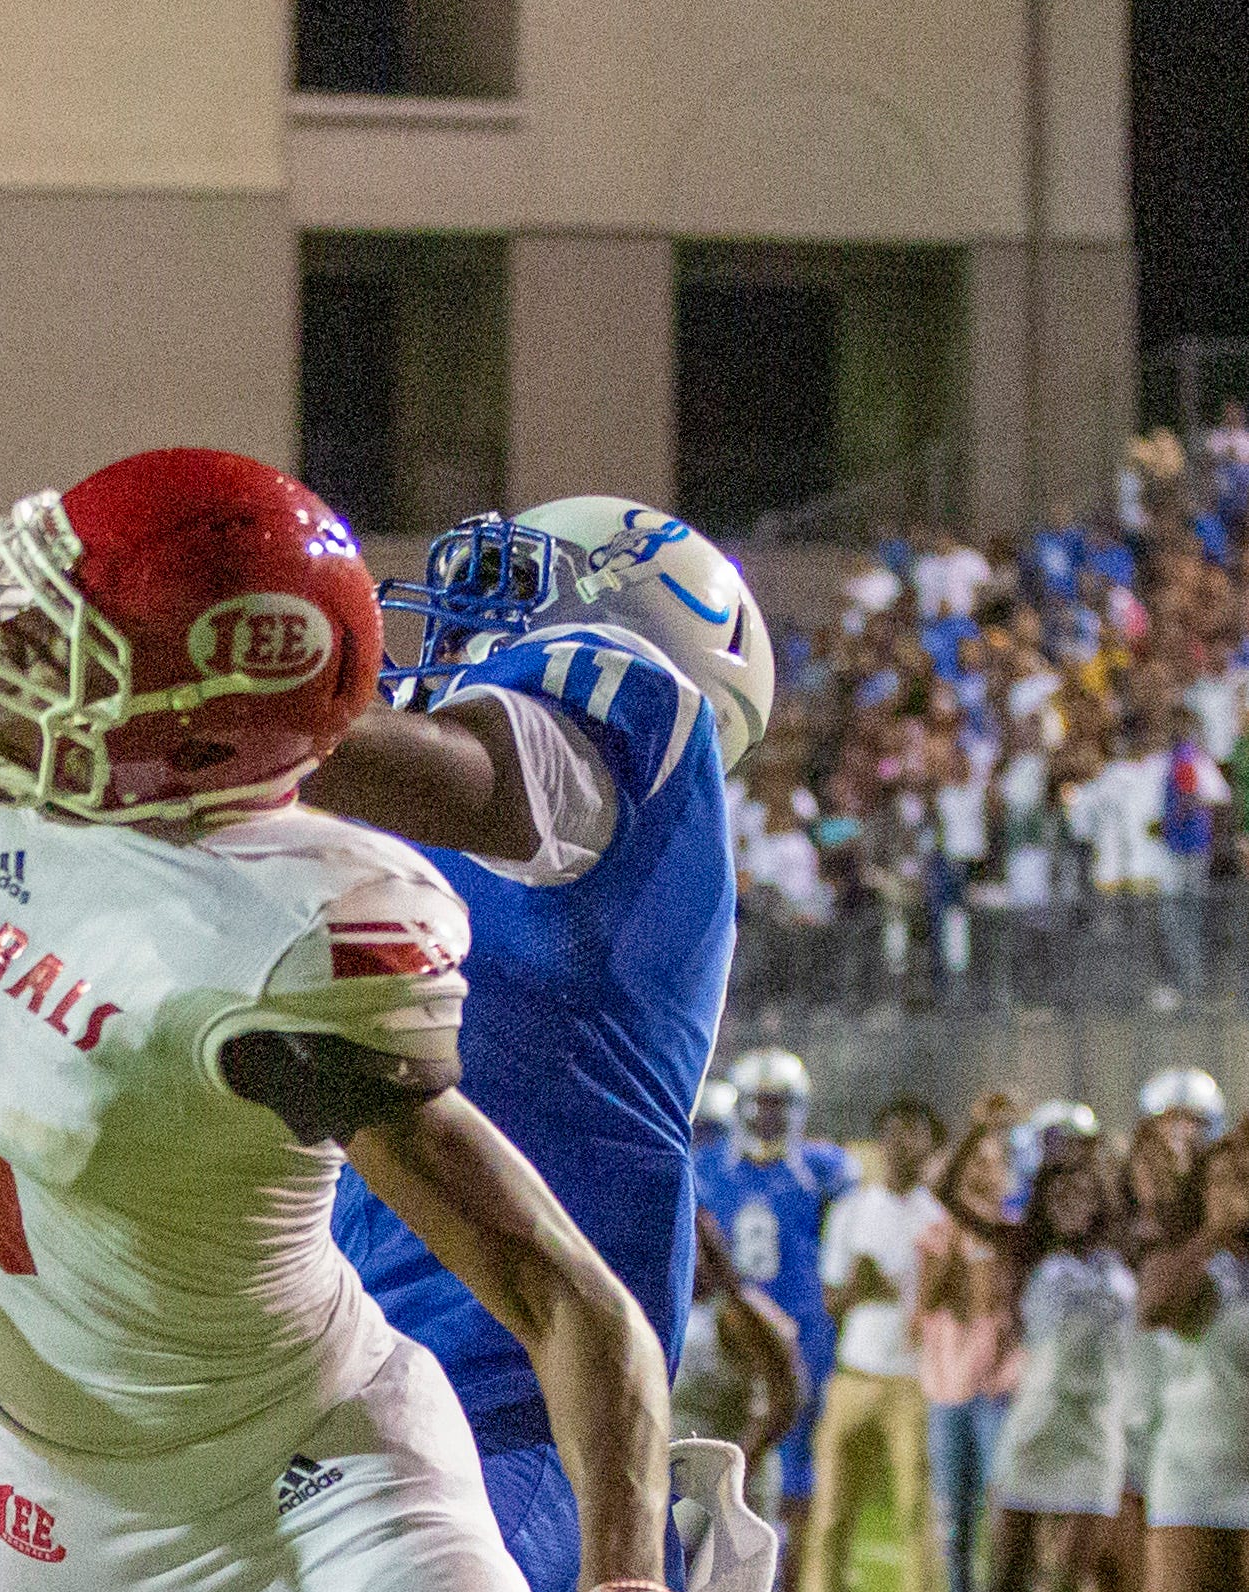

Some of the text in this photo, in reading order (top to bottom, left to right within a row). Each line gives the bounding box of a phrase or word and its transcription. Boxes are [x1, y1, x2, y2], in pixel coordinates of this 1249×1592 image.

[204, 607, 323, 679] LEE
[542, 641, 635, 722] 11
[278, 1467, 344, 1515] adidas
